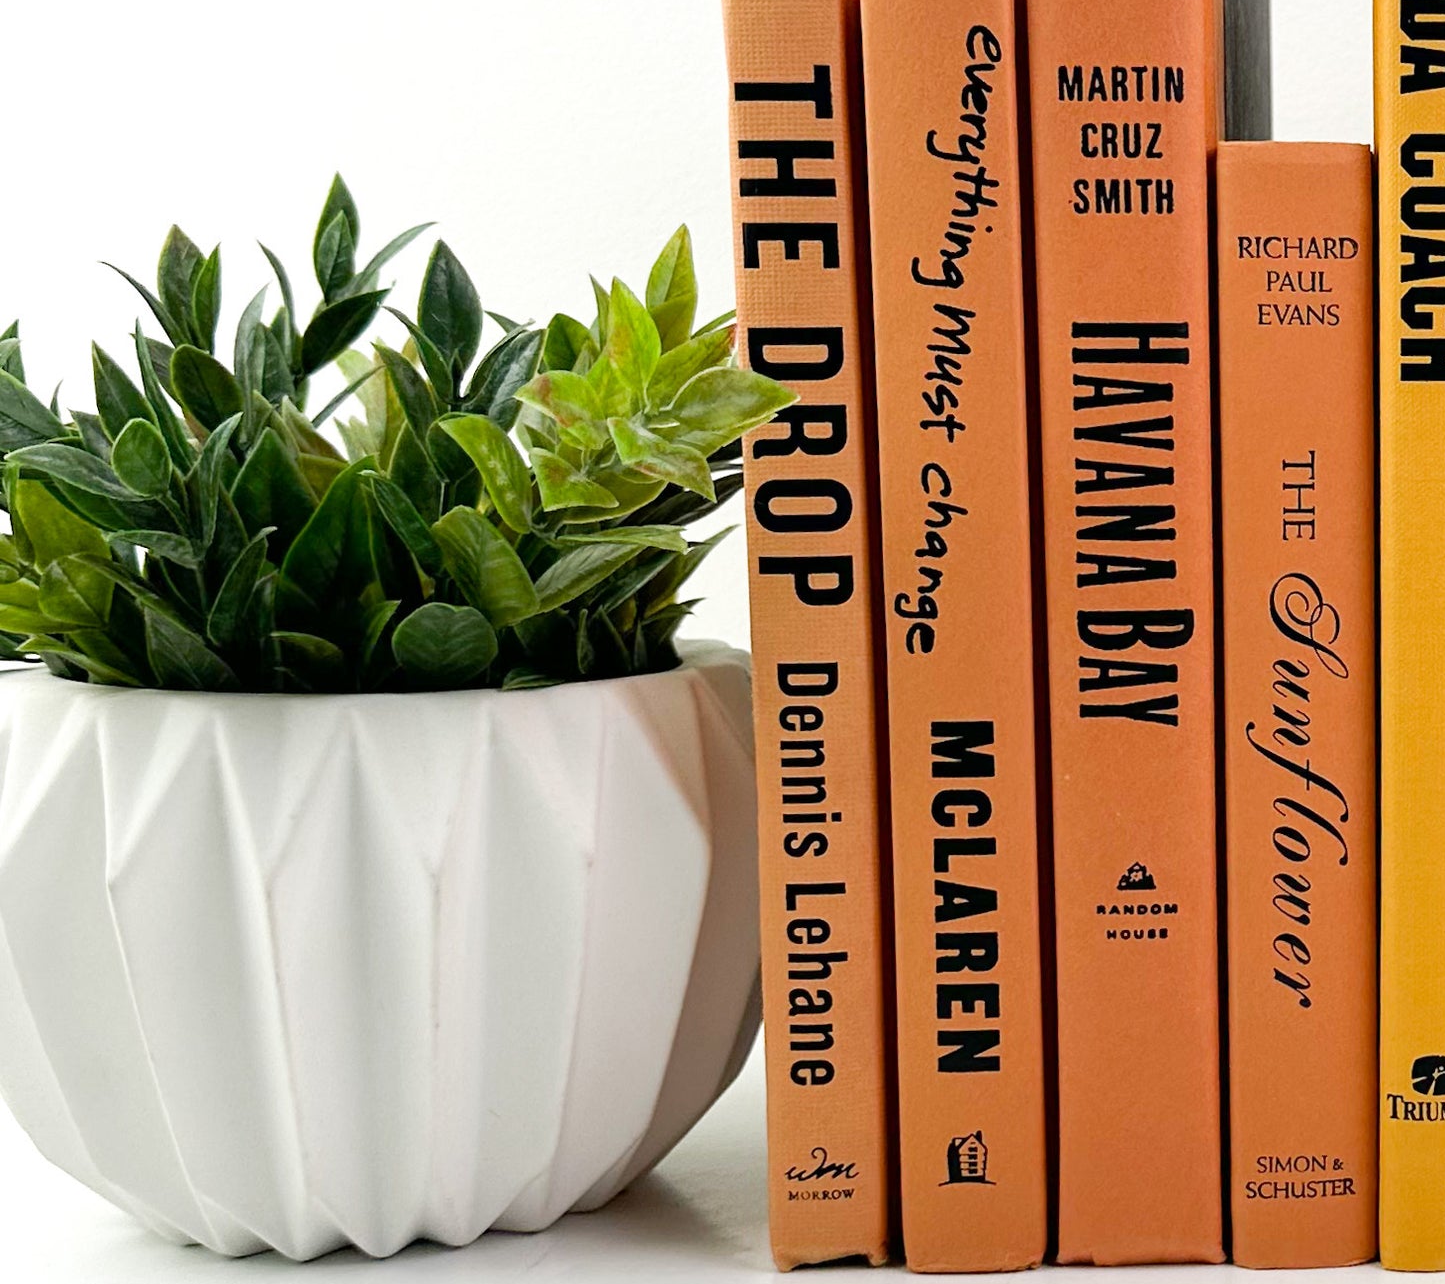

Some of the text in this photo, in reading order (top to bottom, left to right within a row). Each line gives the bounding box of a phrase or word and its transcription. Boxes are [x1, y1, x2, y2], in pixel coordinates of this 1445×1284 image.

[1058, 66, 1183, 103] MARTIN
[912, 25, 1001, 289] everything
[1081, 123, 1162, 158] CRUZ
[1074, 179, 1173, 214] SMITH
[1238, 237, 1358, 259] RICHARD
[1267, 271, 1332, 292] PAUL
[1258, 304, 1339, 326] EVANS
[735, 65, 854, 607] THE DROP
[1283, 451, 1315, 540] THE
[1072, 322, 1194, 726] HAVANA BAY
[894, 463, 968, 655] change
[1246, 573, 1348, 1008] Sunflower
[777, 662, 848, 1085] Dennis Lehane
[931, 721, 1000, 1073] MCLAREN
[1097, 904, 1177, 915] RANDOM
[1107, 928, 1167, 939] HOUSE
[1257, 1155, 1343, 1173] SIMON &
[789, 1189, 854, 1200] MORROW
[1246, 1178, 1355, 1199] SCHUSTER
